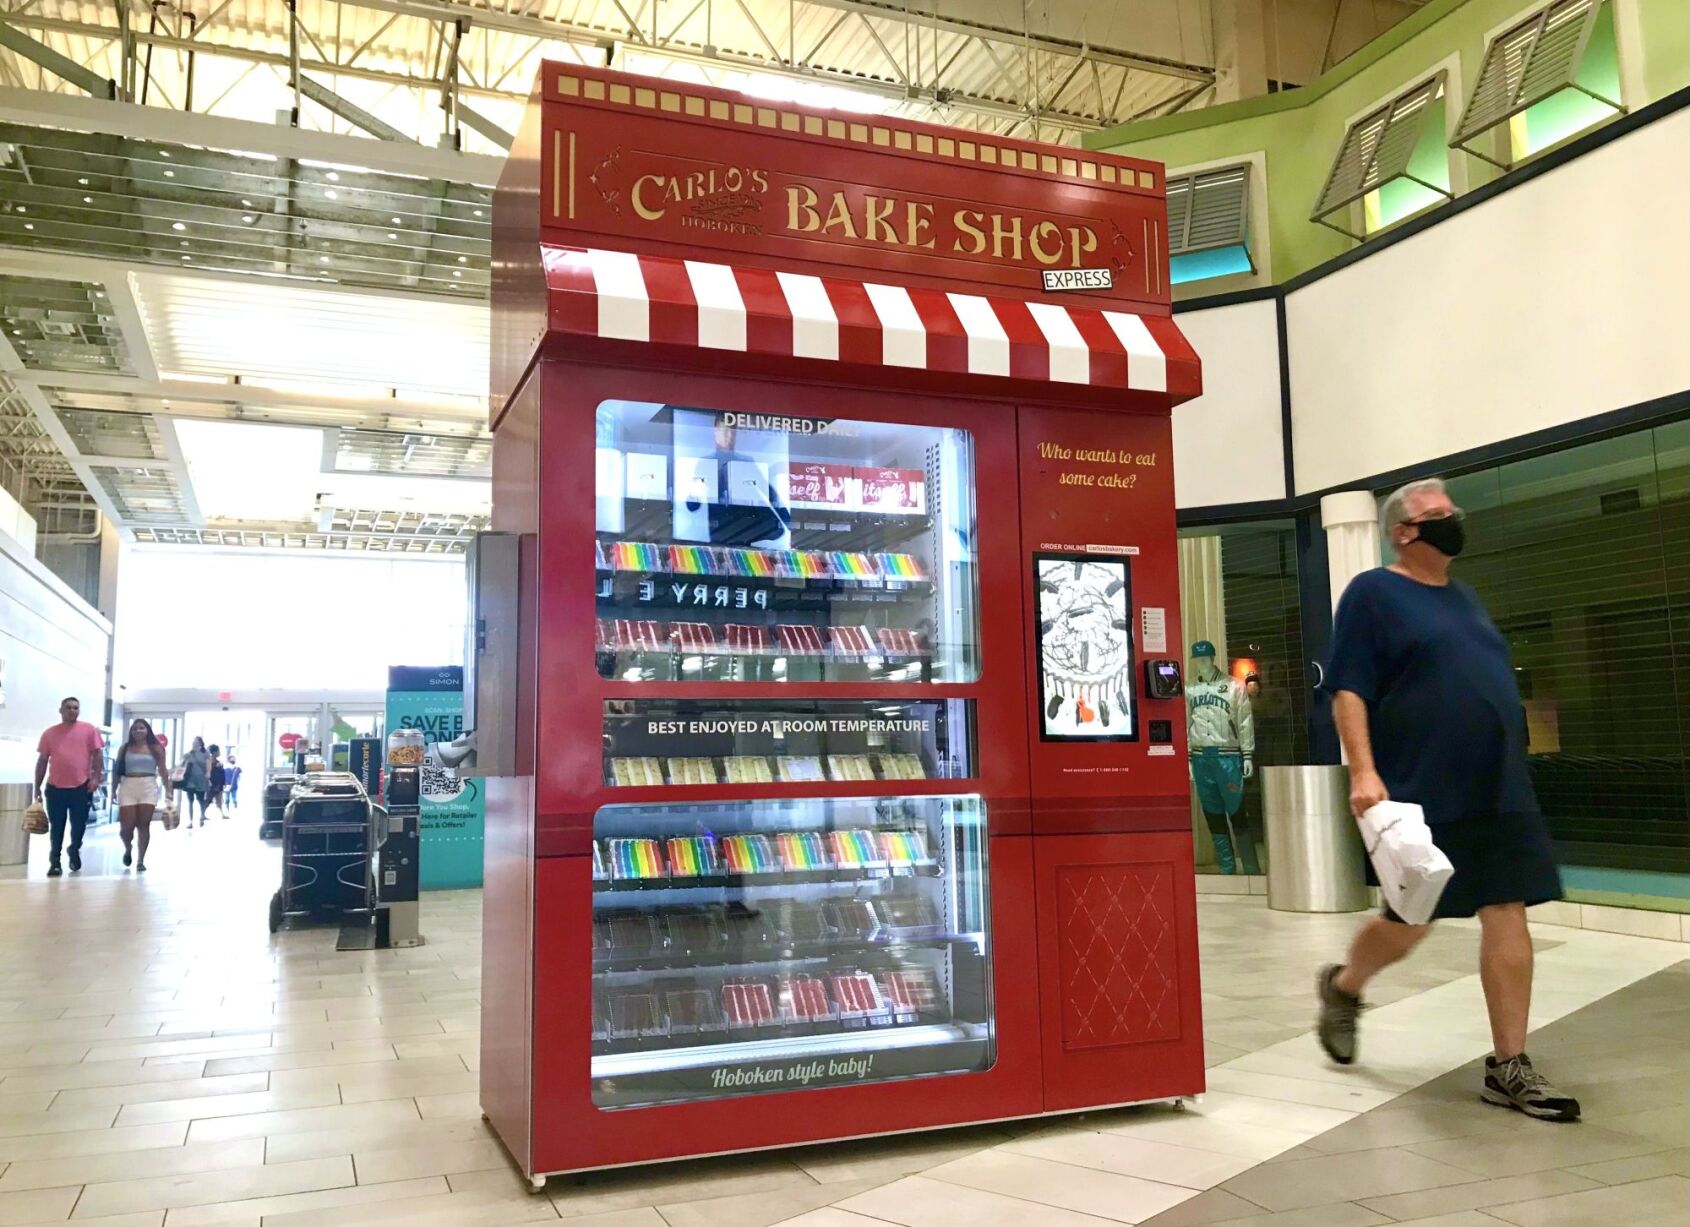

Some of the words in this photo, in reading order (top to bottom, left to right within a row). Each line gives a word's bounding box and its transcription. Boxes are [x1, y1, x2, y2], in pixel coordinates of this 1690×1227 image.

[631, 167, 769, 221] CARLO'S
[784, 184, 936, 249] BAKE
[953, 209, 1098, 267] SHOP
[681, 215, 764, 237] HOBOKEN
[1044, 271, 1111, 288] EXPRESS
[724, 412, 813, 434] DELIVERED
[1037, 442, 1072, 460] Who
[1075, 449, 1116, 463] wants
[1119, 450, 1132, 464] to
[1135, 452, 1157, 466] eat
[1059, 472, 1095, 486] some
[1097, 473, 1137, 488] cake?
[400, 715, 450, 730] SAVE
[648, 720, 686, 734] BEST
[689, 720, 758, 734] ENJOYED
[761, 720, 781, 733] AT
[783, 720, 827, 733] ROOM
[829, 719, 930, 732] TEMPERATURE
[711, 1067, 783, 1088] Hoboken
[786, 1061, 825, 1084] style
[828, 1054, 874, 1078] baby!
